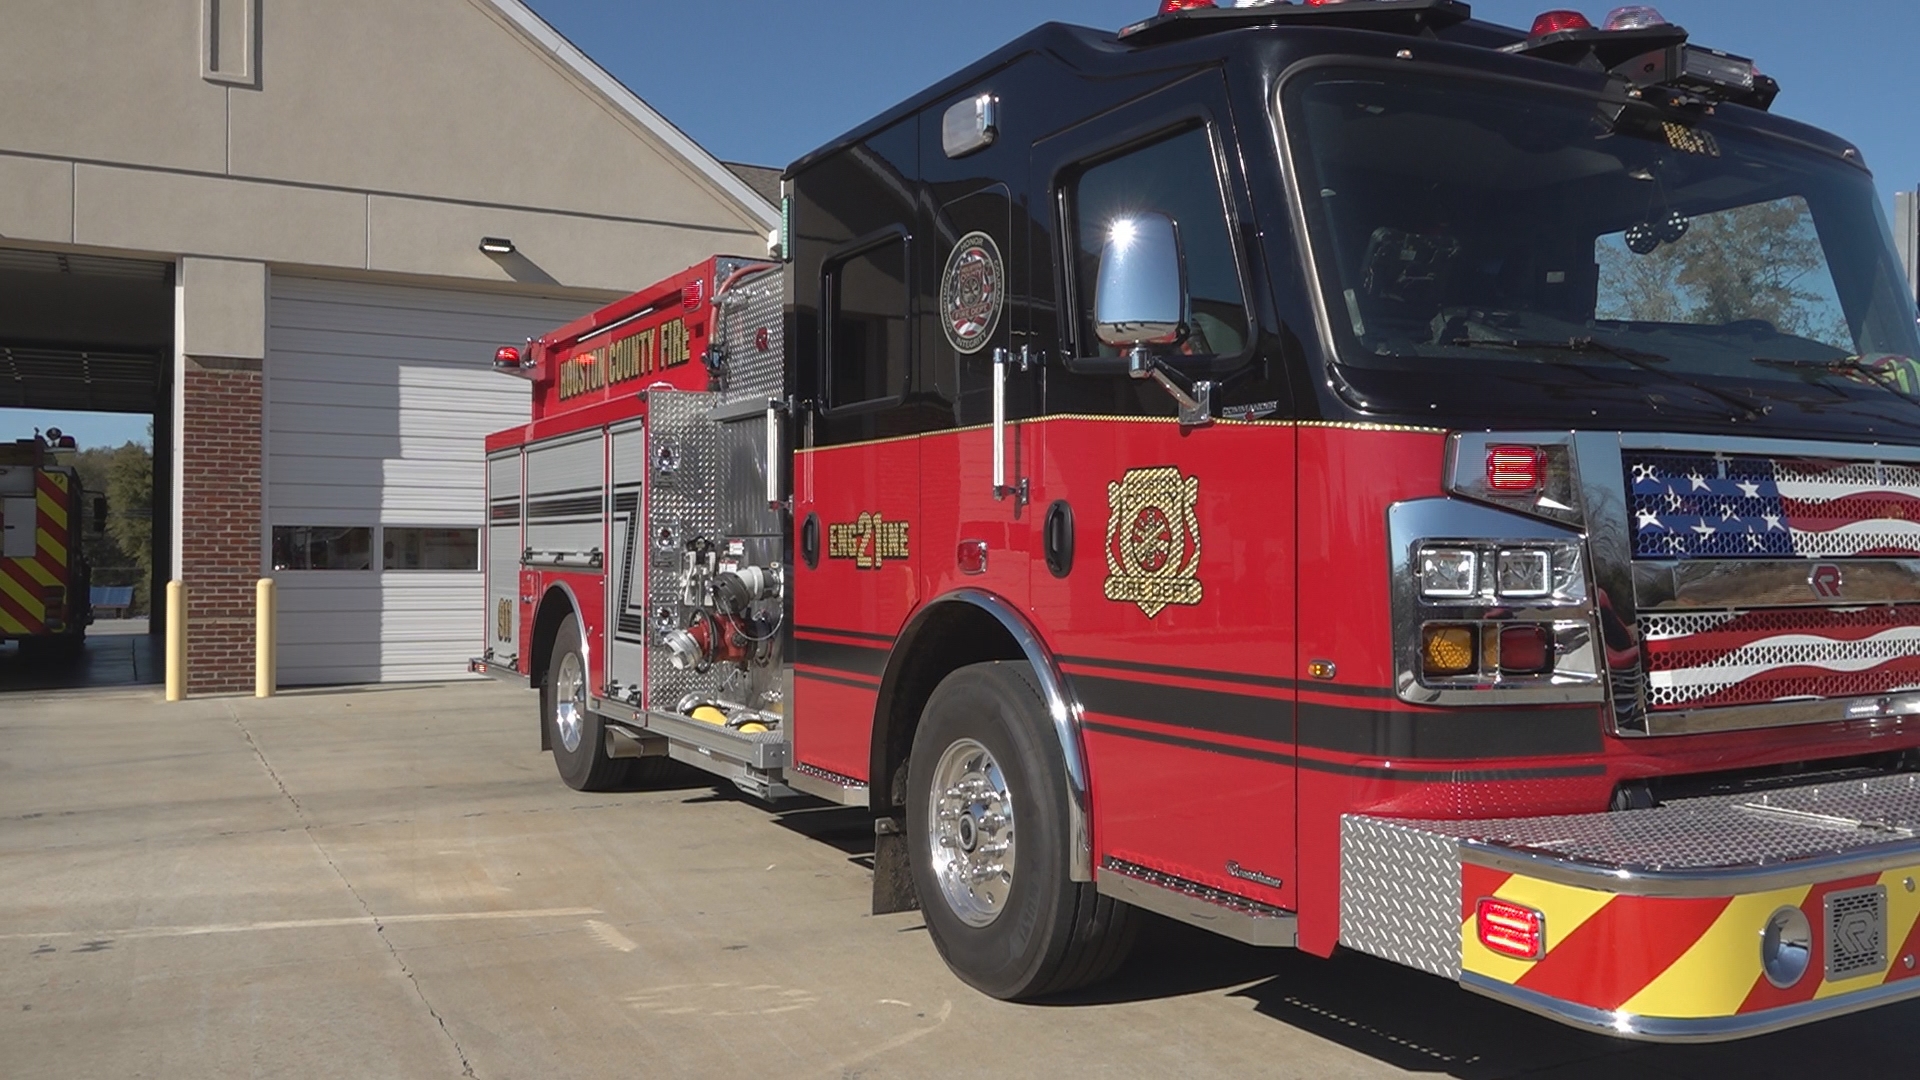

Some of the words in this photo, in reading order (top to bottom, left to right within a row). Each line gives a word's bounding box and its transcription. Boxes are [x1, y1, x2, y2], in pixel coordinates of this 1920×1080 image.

[960, 237, 984, 252] HONOR
[955, 330, 987, 349] INTEGRITY
[559, 347, 606, 401] HOUSTON
[608, 328, 655, 385] COUNTY
[660, 317, 691, 371] FIRE
[1112, 581, 1143, 597] FIRE
[1151, 581, 1193, 599] DEPT
